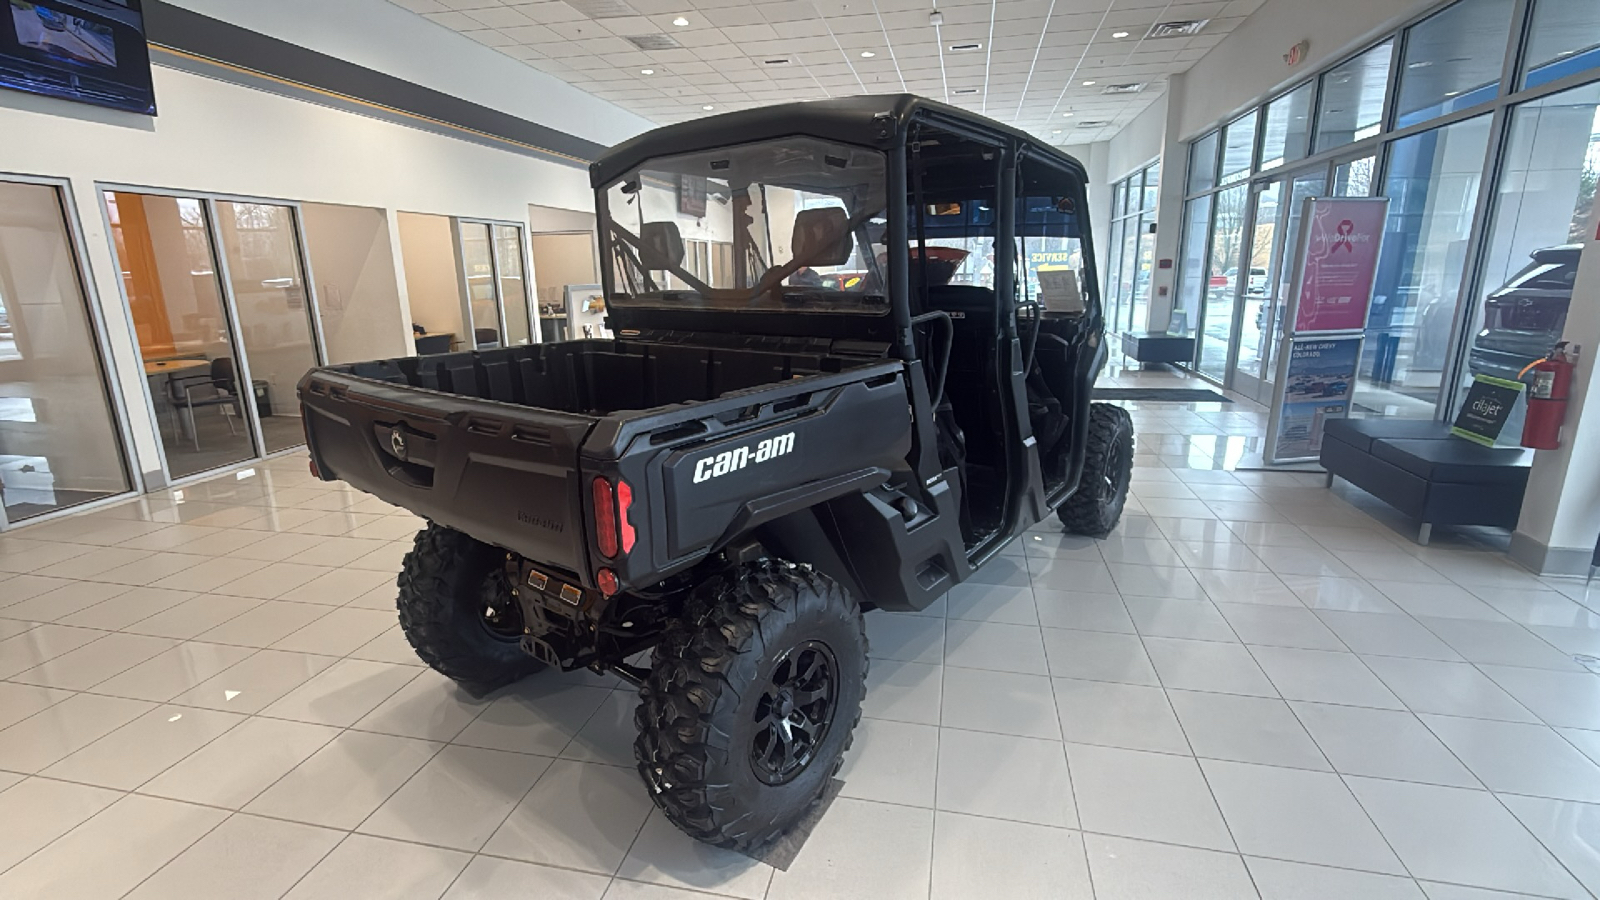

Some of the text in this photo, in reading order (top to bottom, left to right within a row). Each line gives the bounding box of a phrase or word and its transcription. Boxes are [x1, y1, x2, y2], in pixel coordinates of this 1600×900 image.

[1293, 343, 1317, 351] ALL-NEW
[1472, 399, 1502, 416] cilajet
[693, 432, 796, 484] can-am
